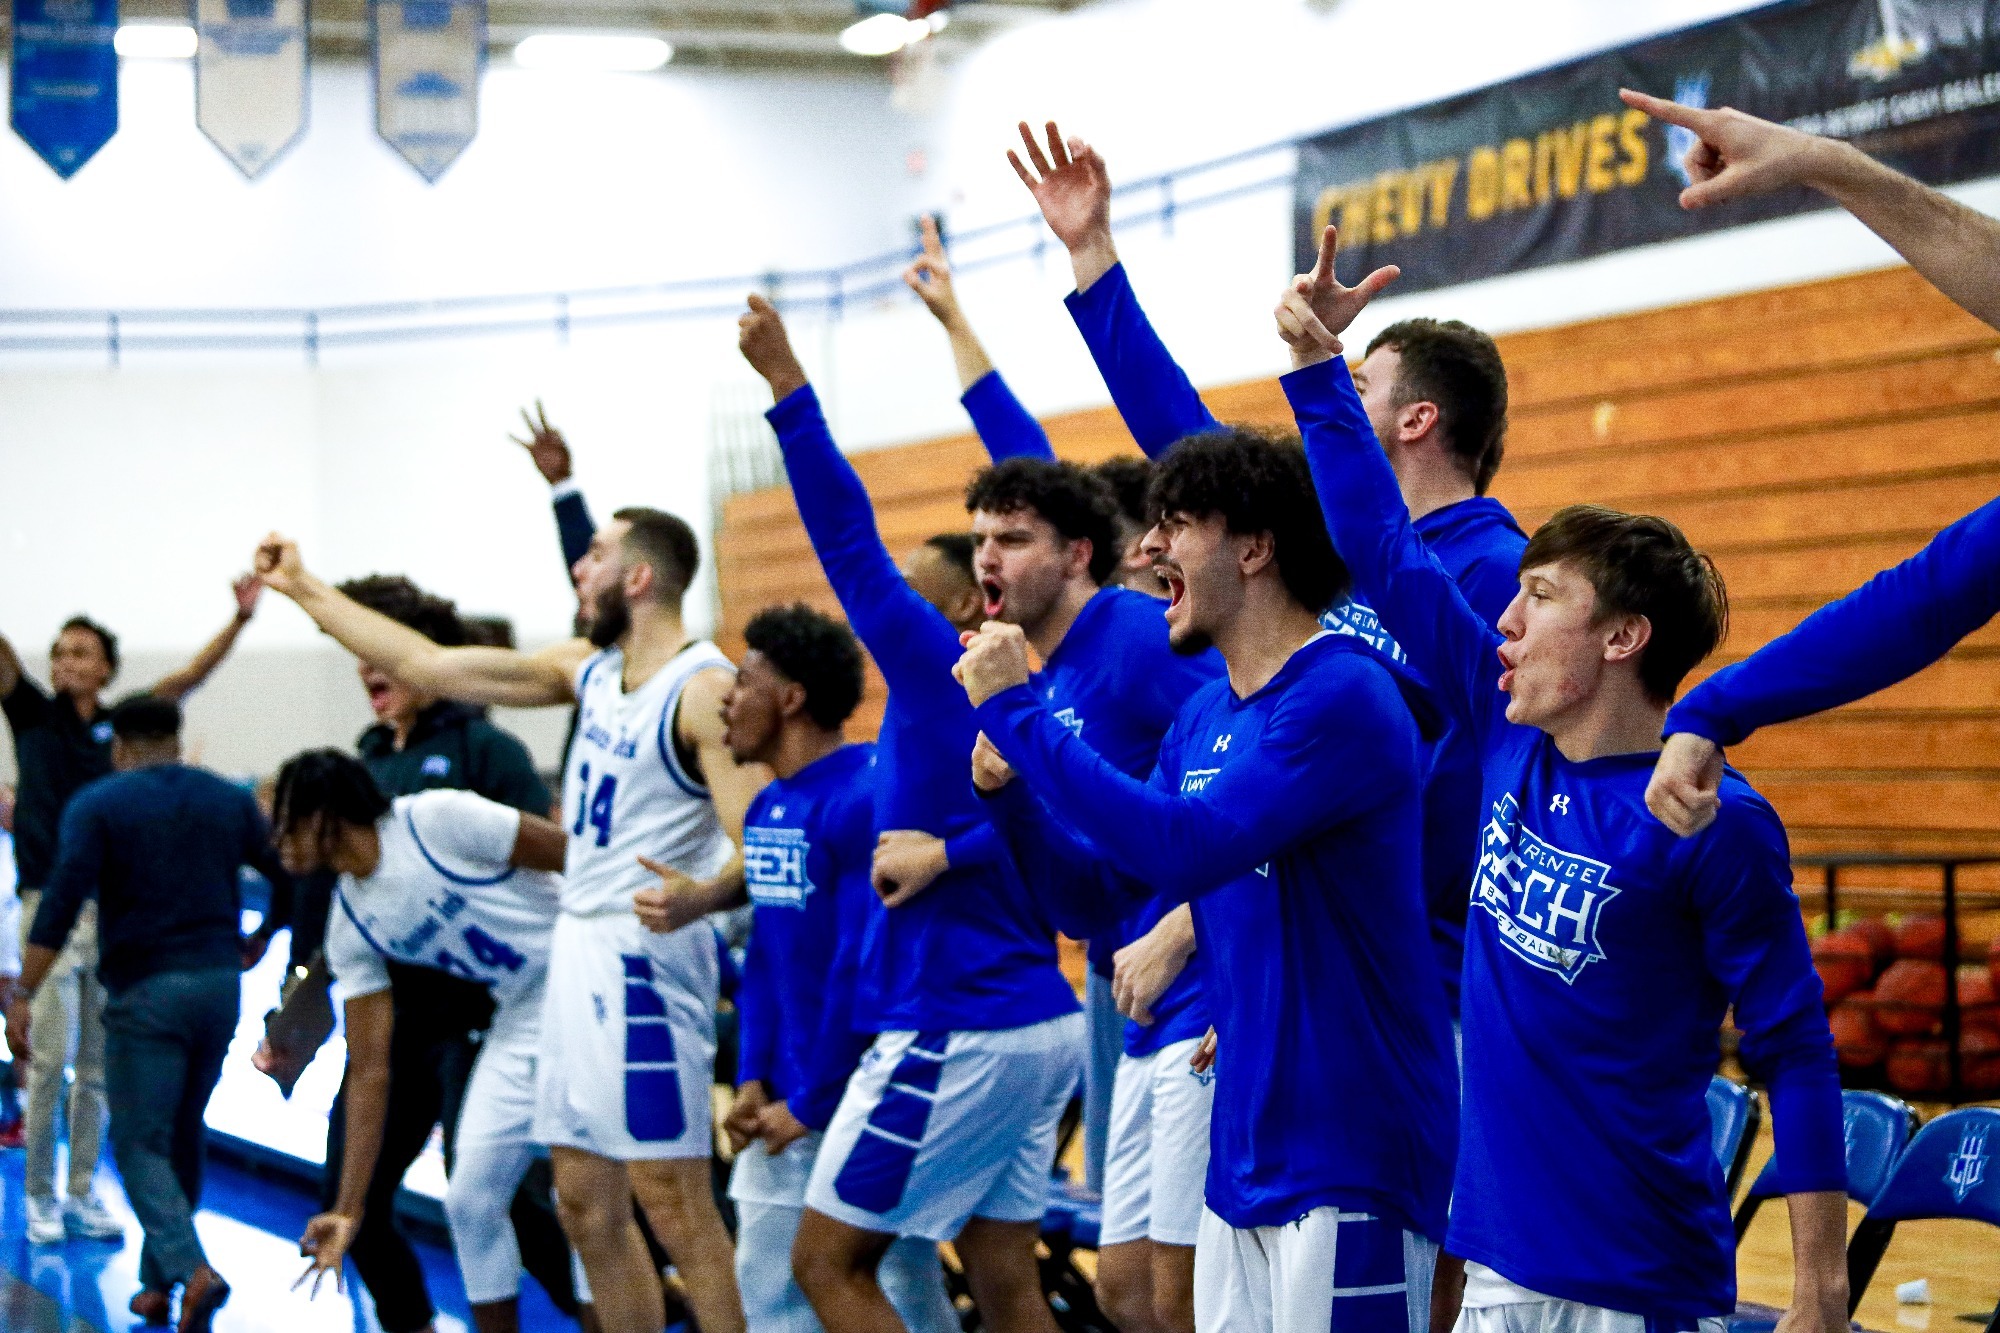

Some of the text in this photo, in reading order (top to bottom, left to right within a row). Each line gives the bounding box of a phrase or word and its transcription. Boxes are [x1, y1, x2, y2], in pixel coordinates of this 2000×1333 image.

[1313, 108, 1649, 250] CHEVY DRIVES
[573, 761, 617, 847] 14
[1500, 803, 1598, 884] LRENCE
[1486, 886, 1558, 960] BETBALL
